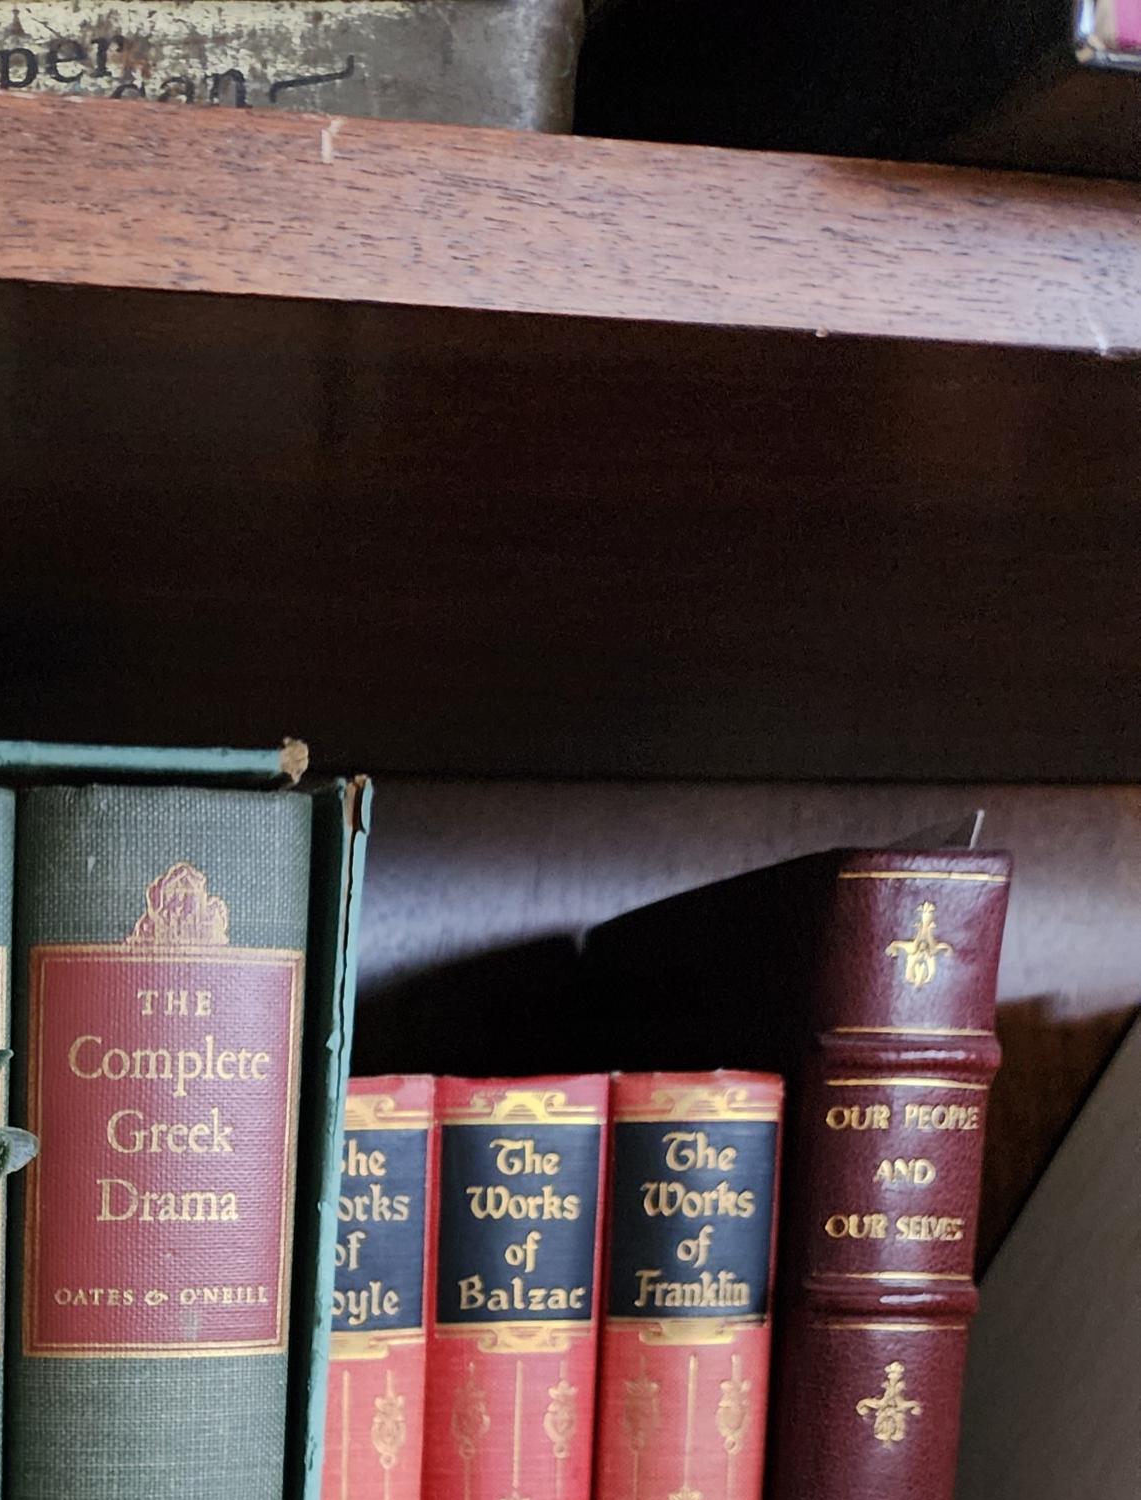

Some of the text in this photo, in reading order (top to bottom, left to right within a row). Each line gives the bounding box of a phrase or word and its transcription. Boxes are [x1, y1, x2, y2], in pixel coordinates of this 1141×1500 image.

[137, 988, 213, 1018] THE
[67, 1034, 271, 1099] Complete
[106, 1106, 236, 1154] Greek
[825, 1103, 981, 1131] OUR PEOPLE
[489, 1136, 560, 1177] The
[661, 1130, 738, 1173] The
[872, 1156, 937, 1186] AND
[96, 1177, 240, 1222] Drama
[465, 1184, 582, 1222] Works
[640, 1181, 757, 1220] Works
[675, 1223, 715, 1269] of
[824, 1212, 965, 1242] OUR SELVES
[503, 1230, 543, 1275] of
[53, 1286, 134, 1307] OATES
[178, 1285, 270, 1307] O'NEILL
[457, 1274, 588, 1313] Balzac
[634, 1268, 752, 1309] Franklin
